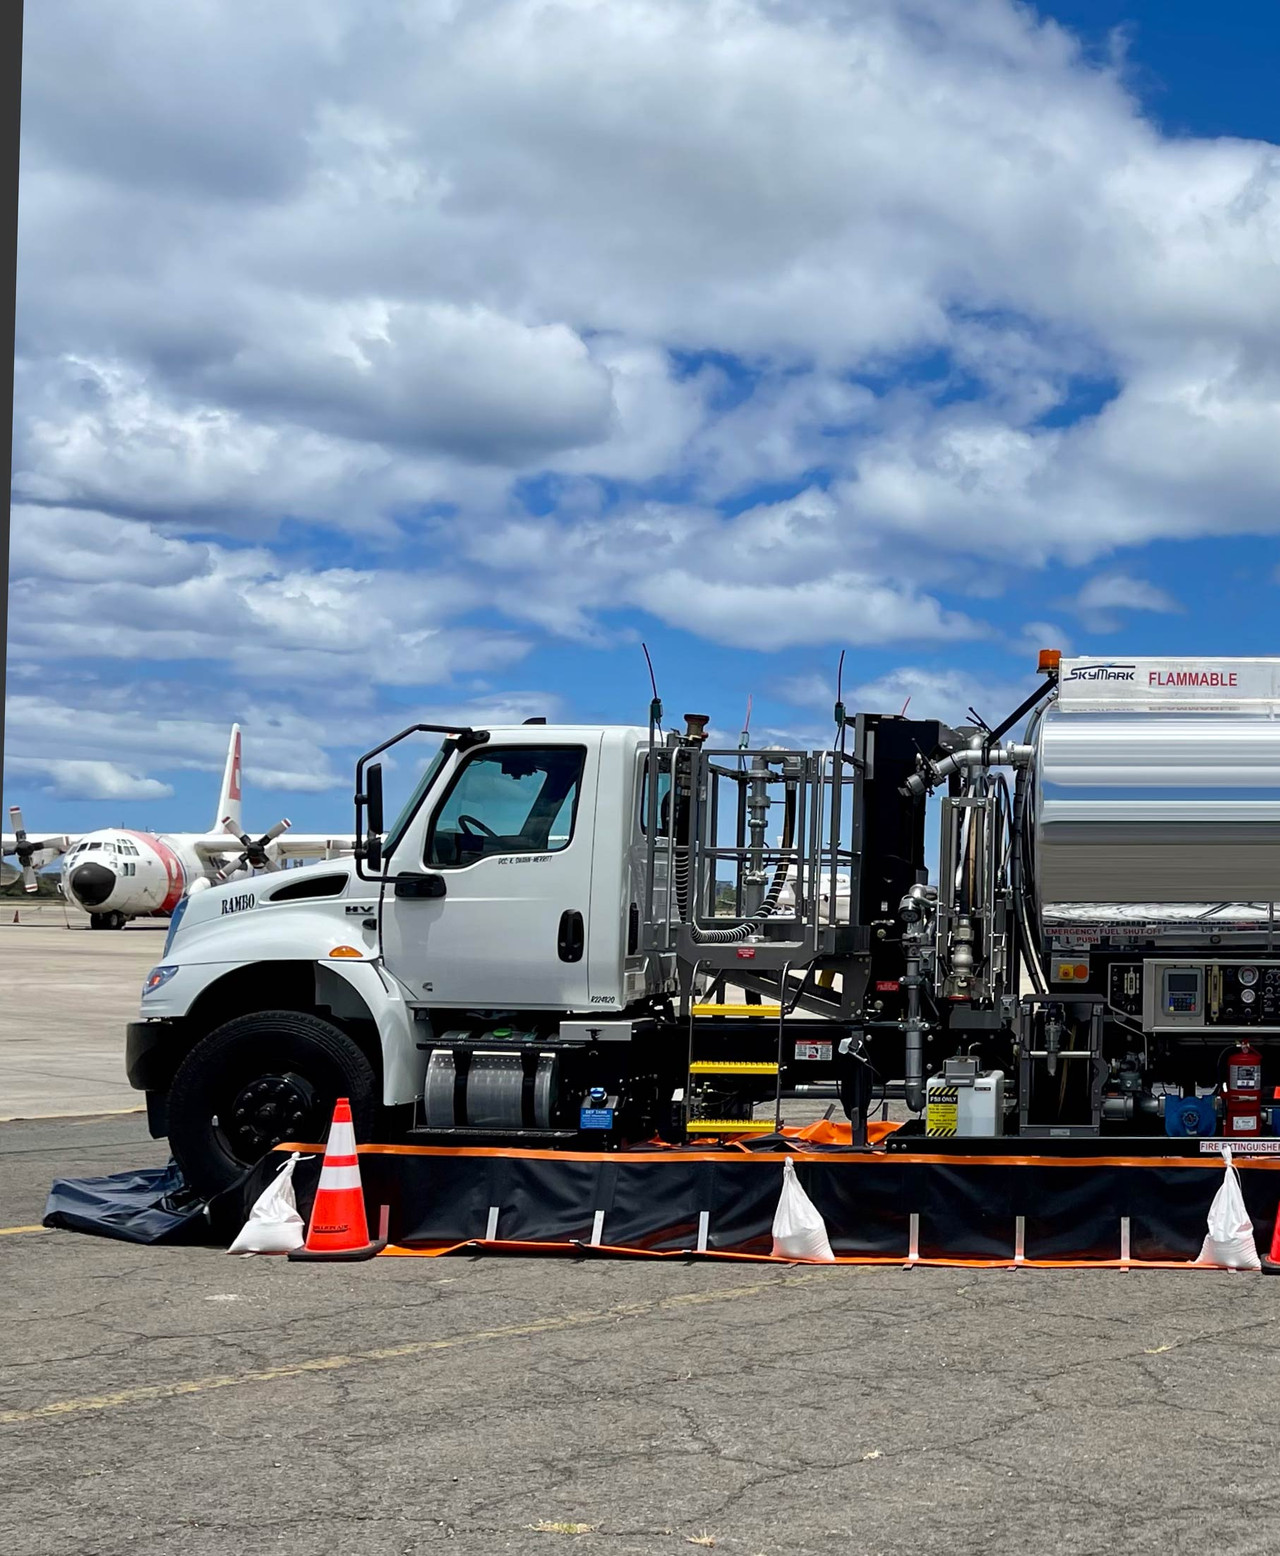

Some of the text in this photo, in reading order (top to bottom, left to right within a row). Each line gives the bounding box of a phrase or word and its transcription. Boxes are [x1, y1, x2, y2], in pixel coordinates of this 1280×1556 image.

[1149, 672, 1237, 686] FLAMMABLE
[221, 893, 255, 915] RAMBO
[345, 906, 374, 914] HV
[1201, 1143, 1219, 1151] FIRE
